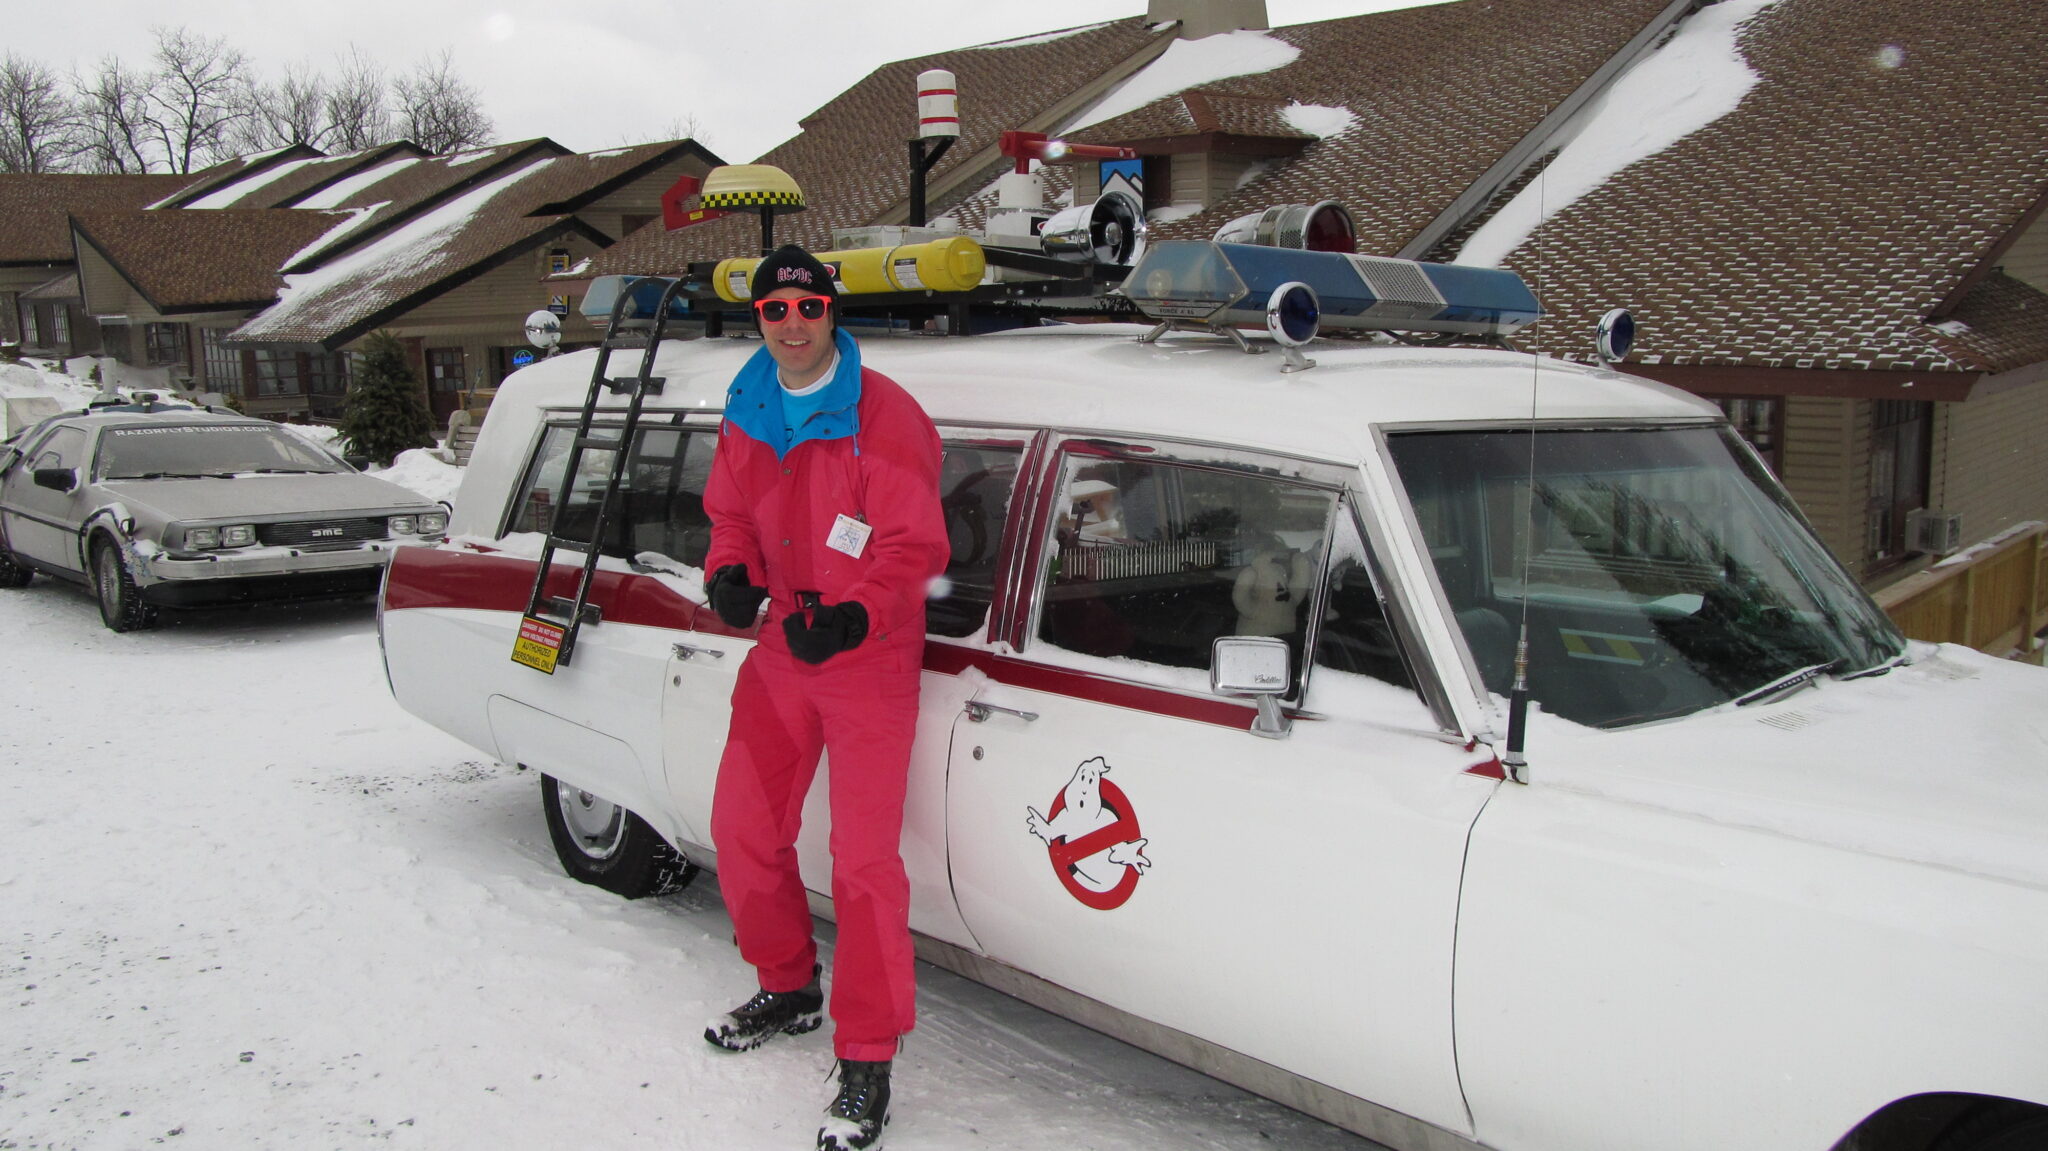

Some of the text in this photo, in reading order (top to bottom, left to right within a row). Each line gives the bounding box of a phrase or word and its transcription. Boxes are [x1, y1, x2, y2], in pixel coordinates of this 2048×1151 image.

[311, 527, 344, 537] DMC
[522, 641, 552, 657] AUTHORIZED
[514, 649, 554, 670] PERSONNEL ONLY
